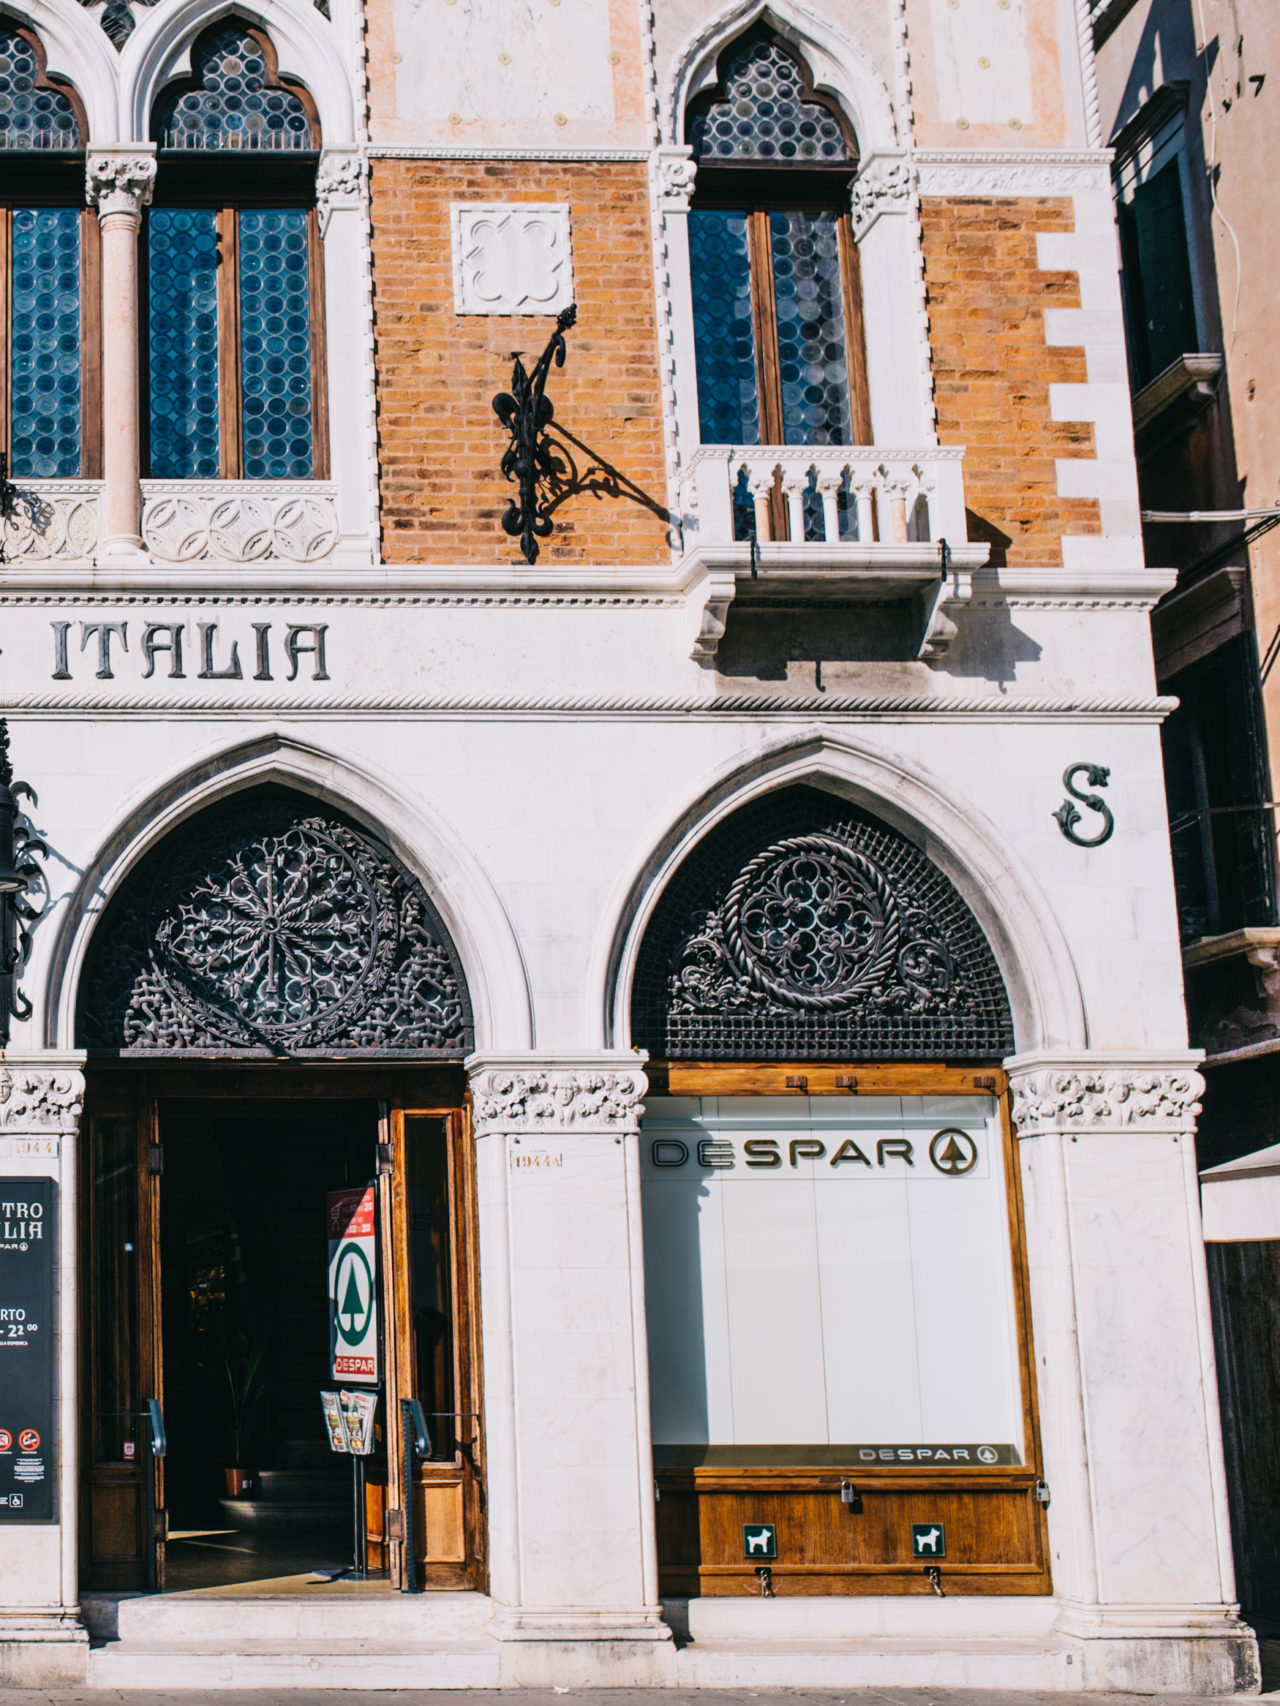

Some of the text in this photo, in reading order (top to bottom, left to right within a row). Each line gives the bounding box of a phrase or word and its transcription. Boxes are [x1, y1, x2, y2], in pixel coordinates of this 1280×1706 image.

[50, 620, 332, 681] ITALIA
[1051, 762, 1114, 848] S
[652, 1138, 914, 1168] DESPAR
[336, 1358, 374, 1372] DESPAR
[858, 1449, 970, 1460] DESPAR
